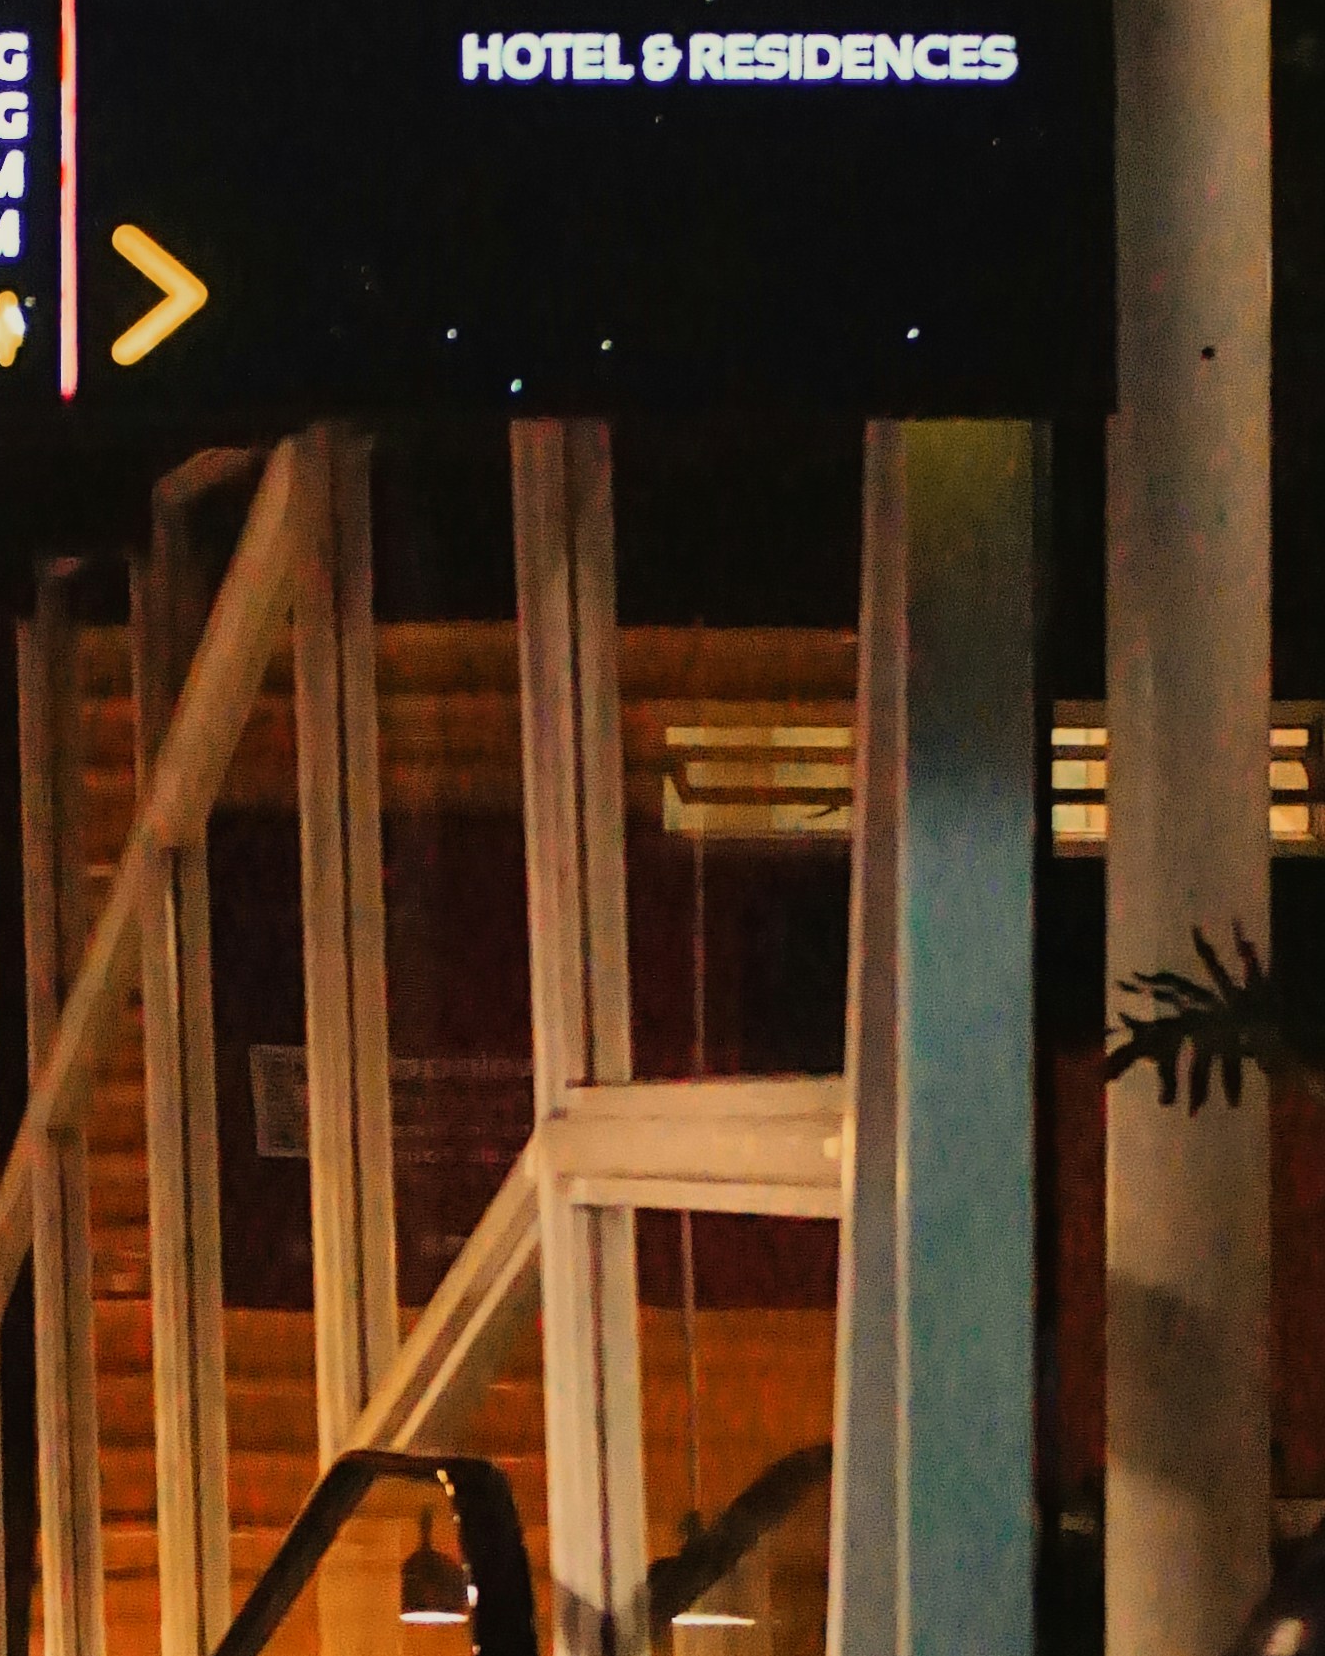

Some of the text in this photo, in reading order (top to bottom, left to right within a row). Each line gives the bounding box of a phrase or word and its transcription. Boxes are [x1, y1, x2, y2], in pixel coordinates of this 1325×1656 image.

[462, 32, 1019, 82] HOTEL & RESIDENCES
